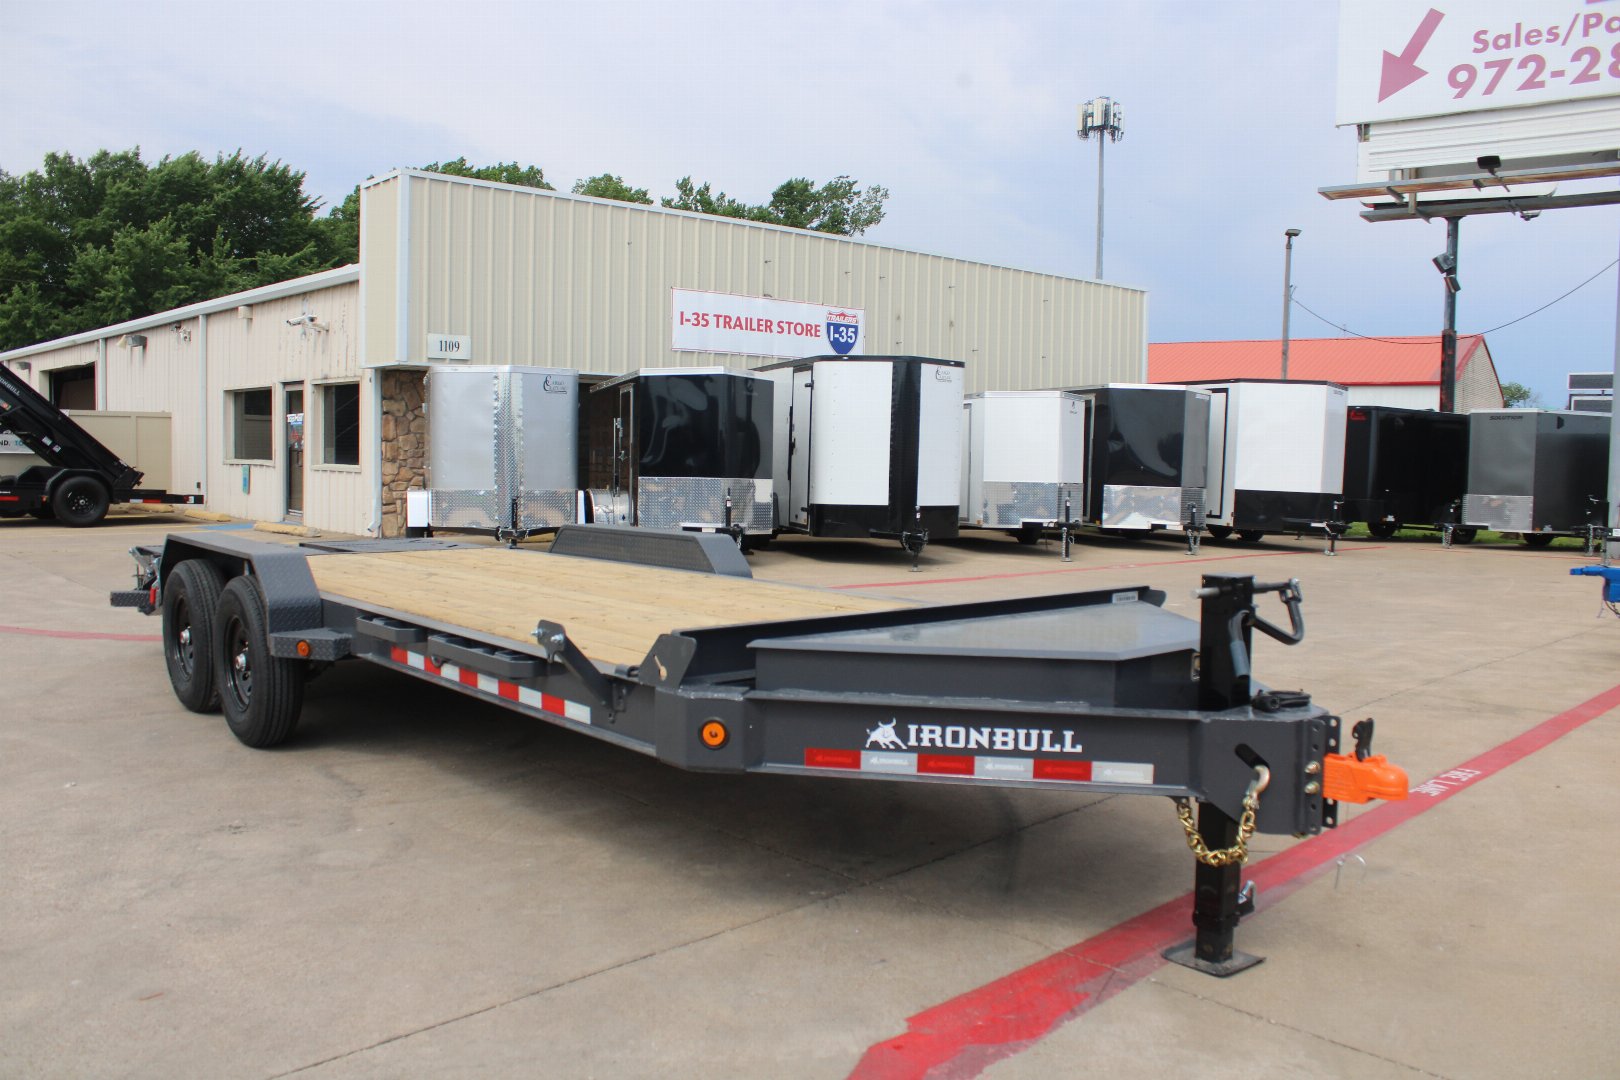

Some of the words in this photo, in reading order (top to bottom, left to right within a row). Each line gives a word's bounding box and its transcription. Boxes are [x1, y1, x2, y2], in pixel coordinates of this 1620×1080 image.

[680, 311, 710, 328] I-35
[713, 314, 773, 334] TRAILER
[776, 320, 821, 338] STORE
[827, 314, 857, 323] TRAILERS
[830, 325, 856, 343] I-35
[439, 340, 460, 352] 1109
[907, 724, 1083, 753] IRONBULL
